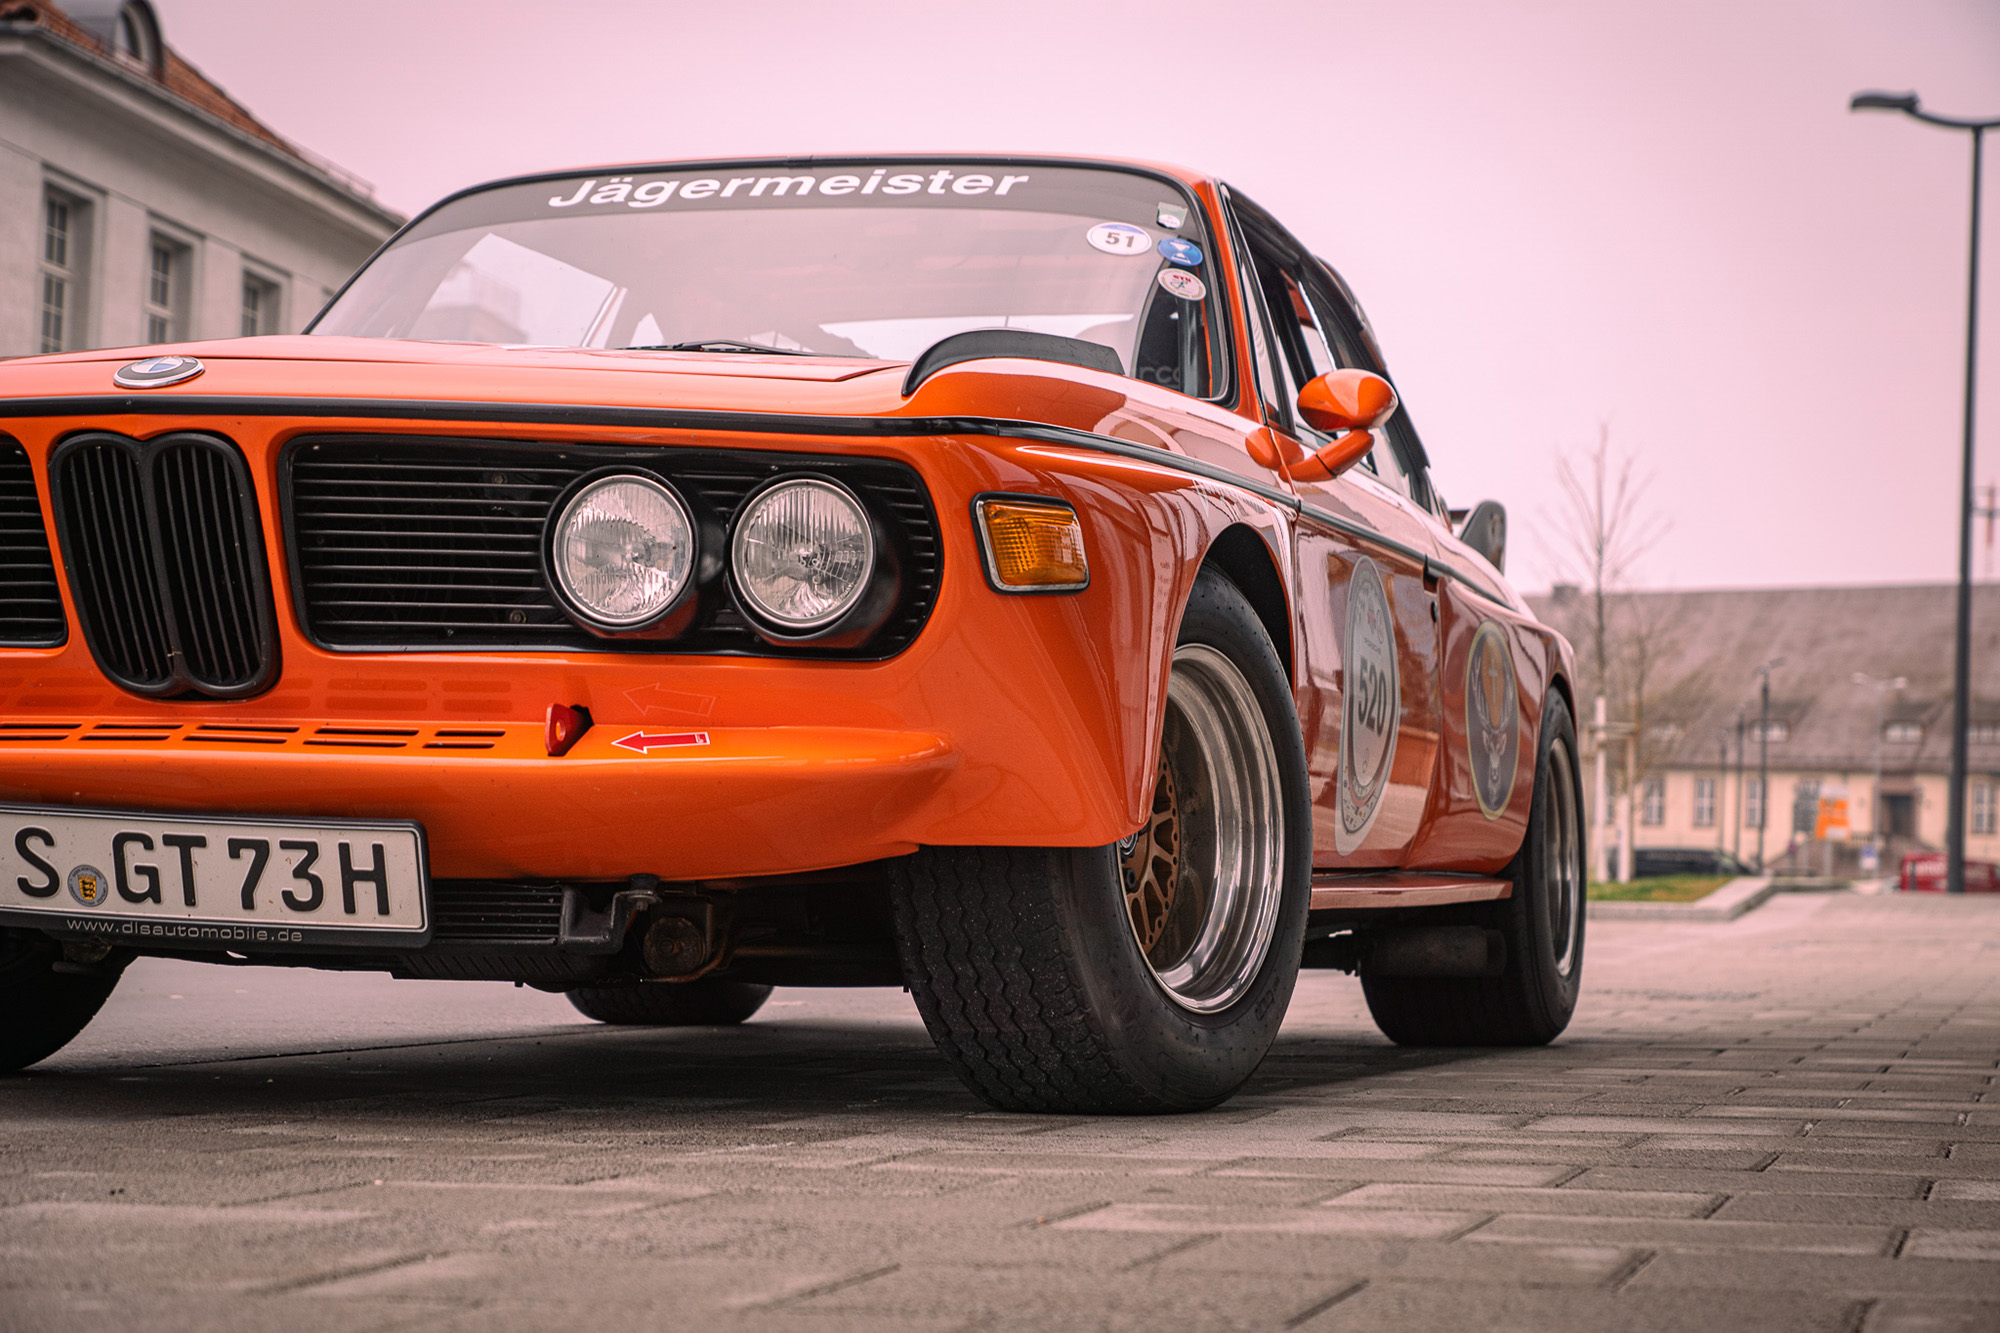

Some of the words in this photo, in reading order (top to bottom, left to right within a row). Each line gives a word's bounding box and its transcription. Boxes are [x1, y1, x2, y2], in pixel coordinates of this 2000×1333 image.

[548, 169, 1030, 208] Jägermeister
[1105, 232, 1135, 248] 51
[1358, 656, 1387, 737] 520
[14, 826, 61, 898] S
[111, 831, 208, 907] GT
[227, 836, 390, 916] 73H
[66, 919, 303, 942] www.dlsautomobile.de
